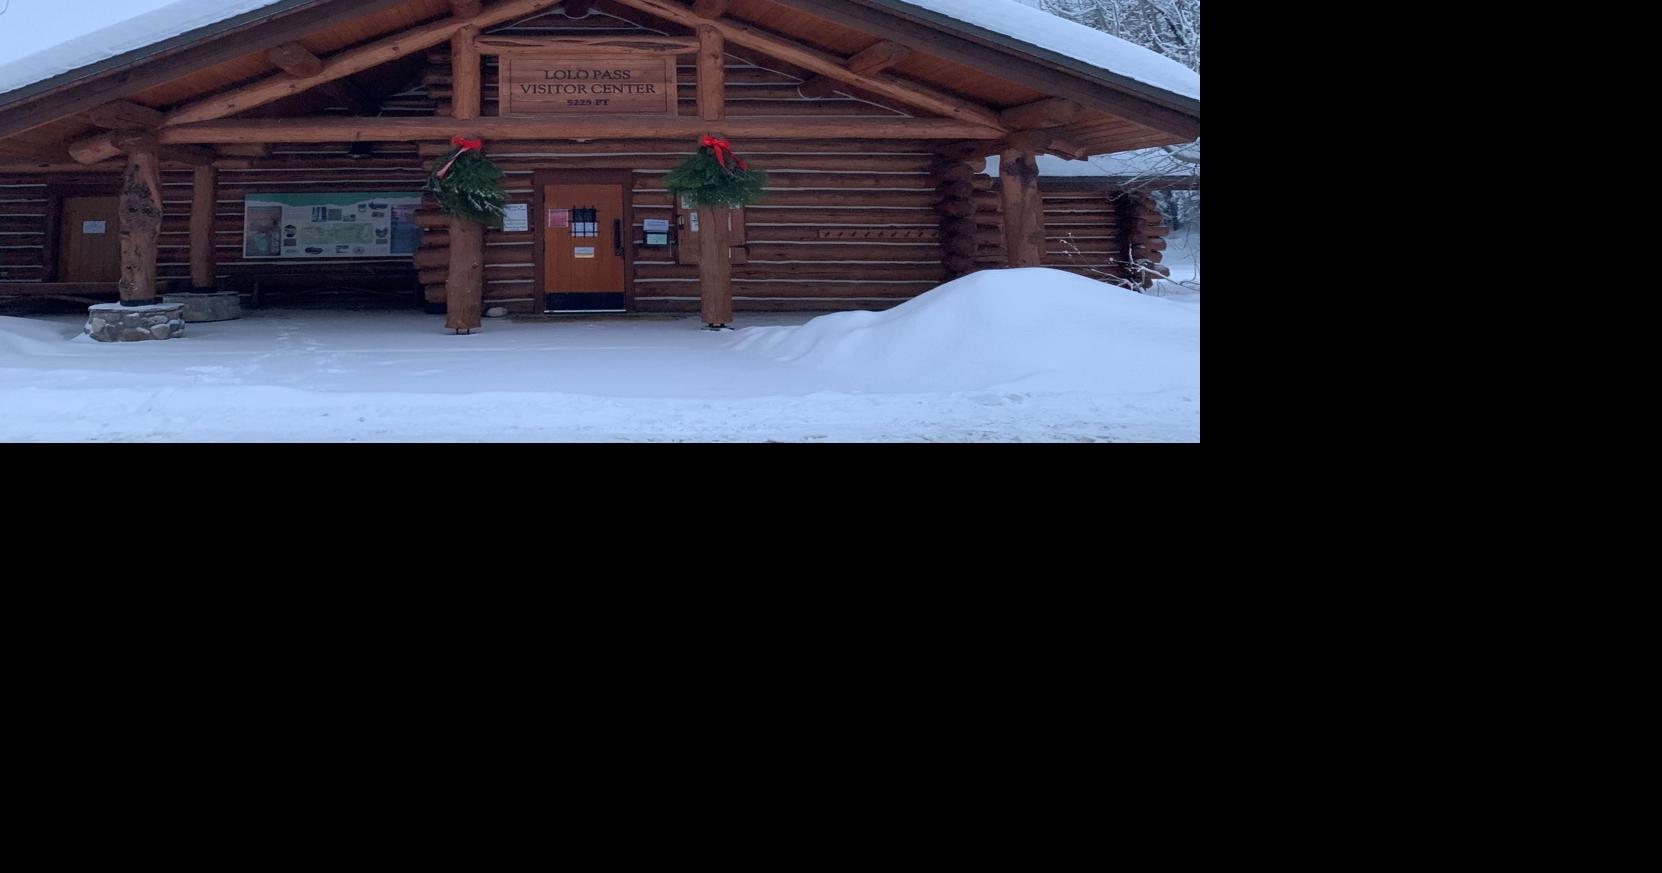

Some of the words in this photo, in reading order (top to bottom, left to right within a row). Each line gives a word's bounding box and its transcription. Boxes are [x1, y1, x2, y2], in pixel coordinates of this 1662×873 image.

[544, 69, 590, 80] LOLO
[592, 69, 631, 80] PASS
[520, 83, 588, 94] VISITOR
[591, 83, 656, 94] CENTER
